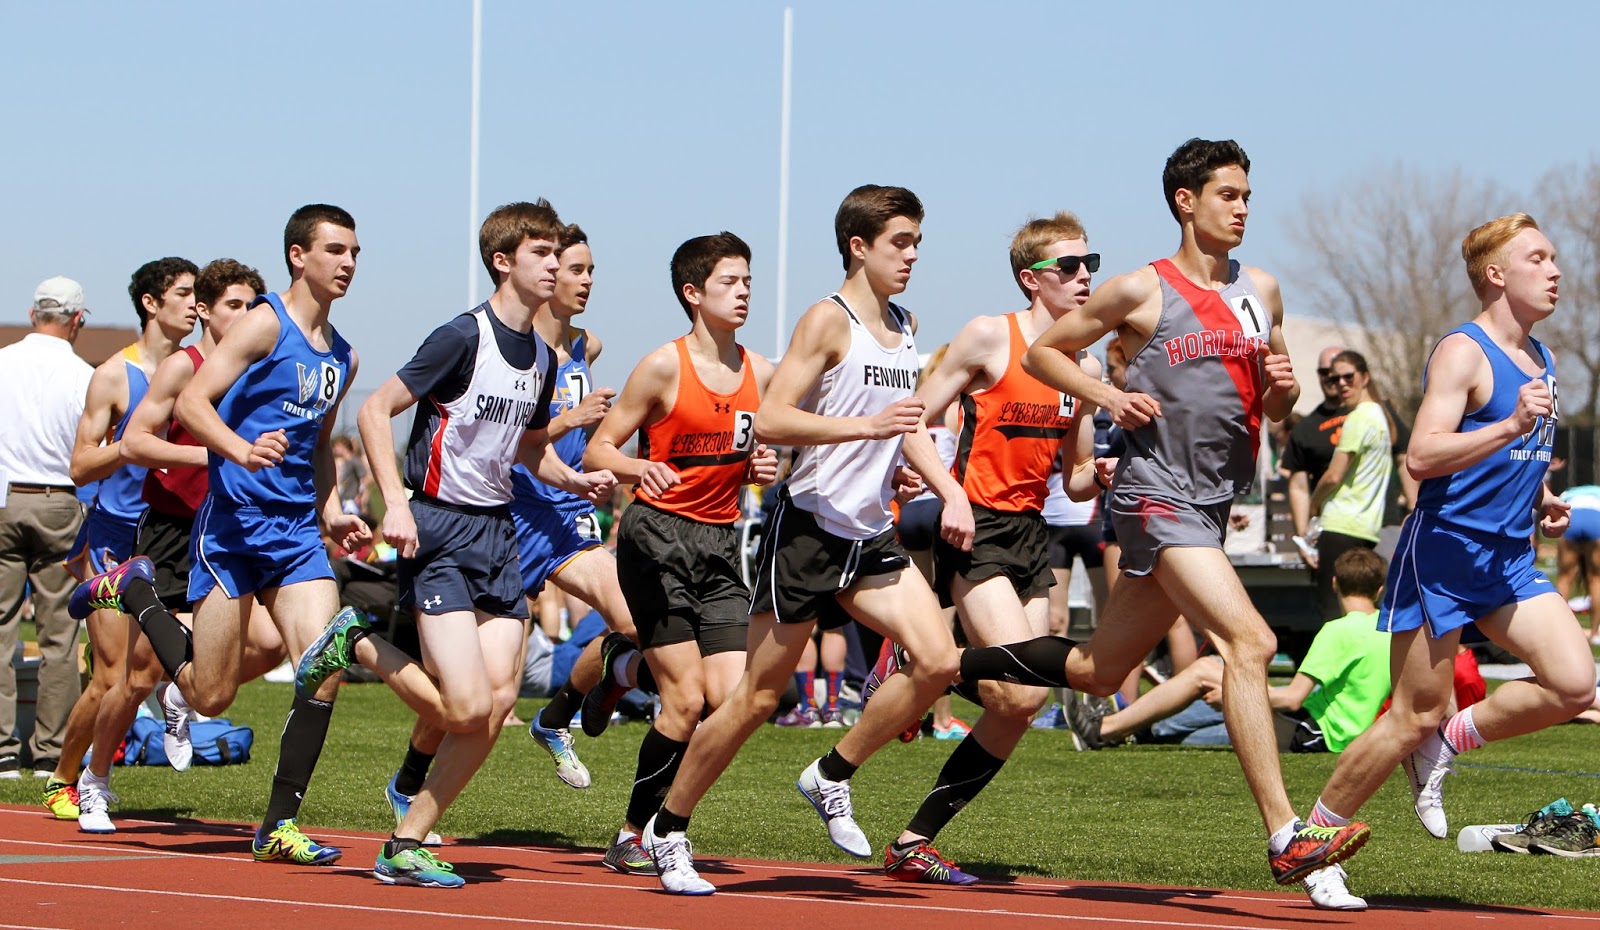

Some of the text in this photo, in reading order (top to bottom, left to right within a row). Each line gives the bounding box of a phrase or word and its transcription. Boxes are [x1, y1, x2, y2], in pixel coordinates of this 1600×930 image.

[1240, 298, 1261, 333] 1
[324, 366, 335, 400] 8
[570, 375, 583, 406] 7
[282, 401, 306, 418] TRACK
[474, 394, 514, 425] SAINT
[1063, 394, 1074, 415] 4
[736, 414, 753, 449] 3
